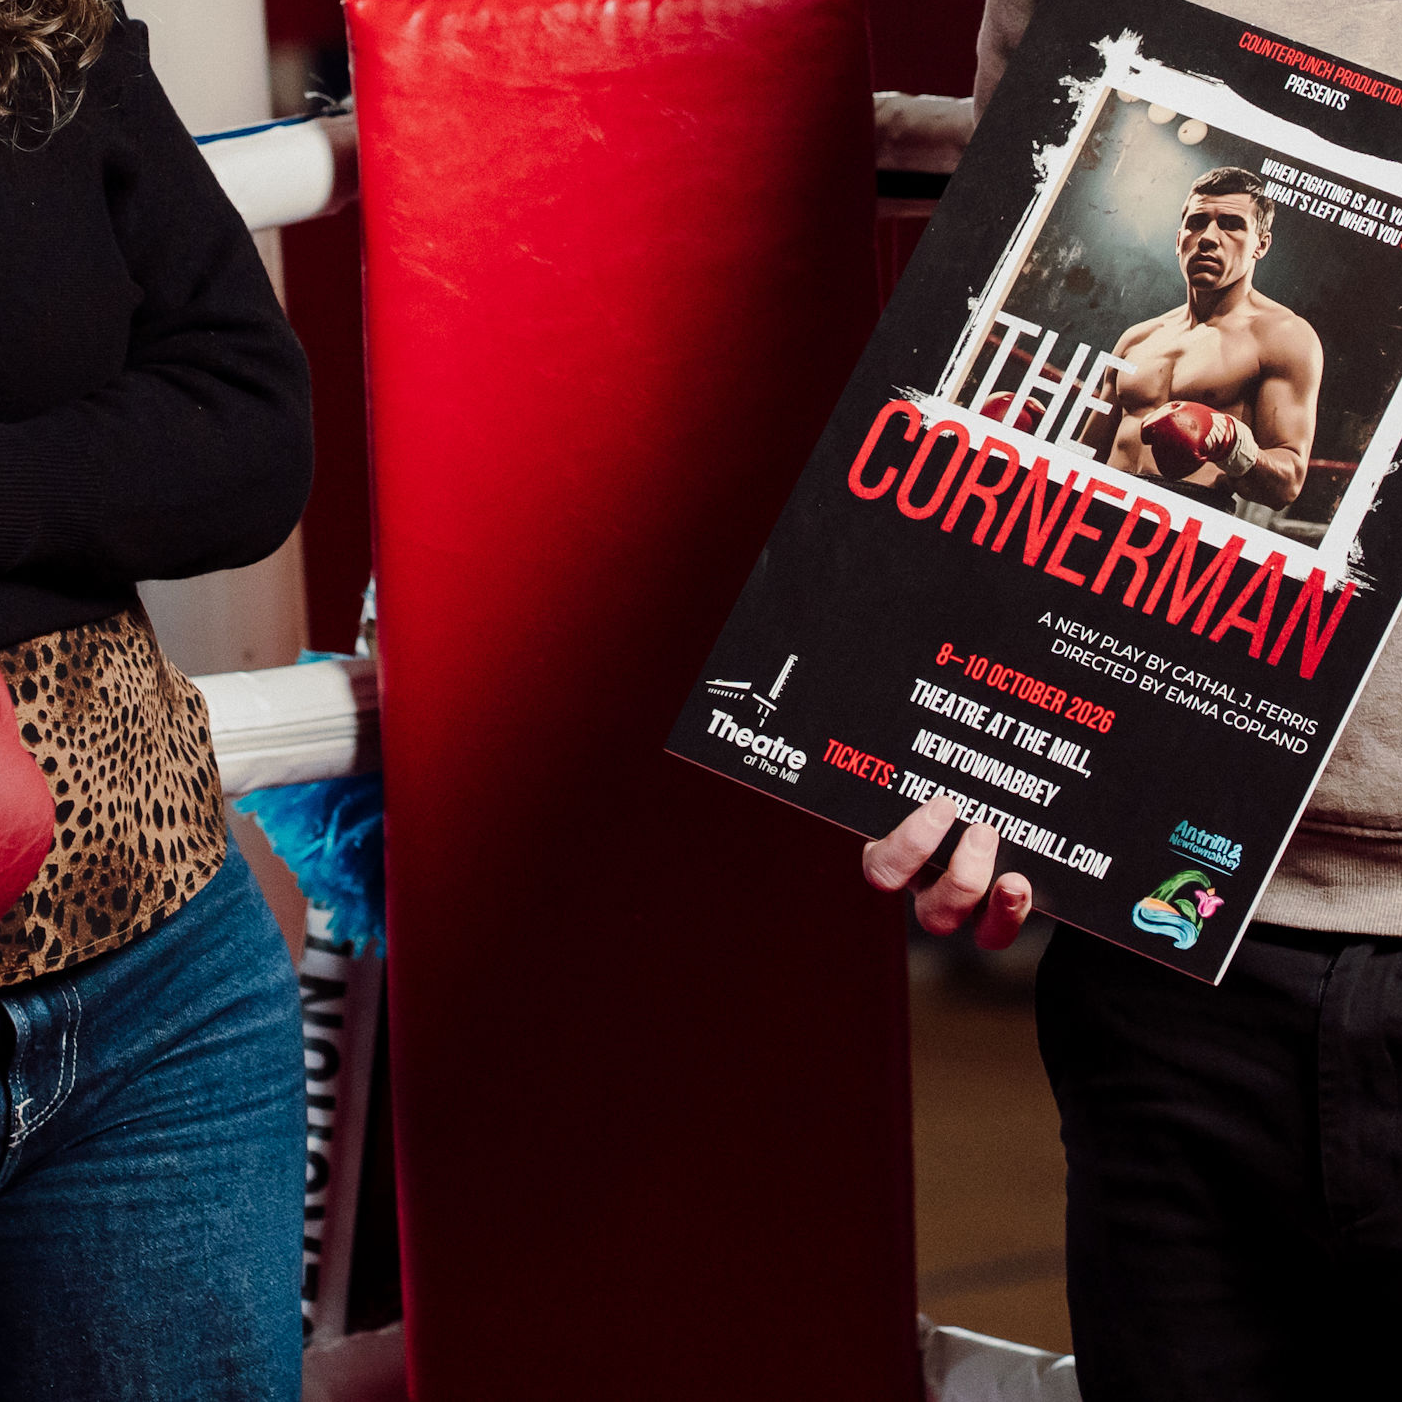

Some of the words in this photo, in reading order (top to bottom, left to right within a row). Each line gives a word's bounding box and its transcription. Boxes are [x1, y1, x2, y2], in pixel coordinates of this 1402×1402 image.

[1238, 31, 1336, 80] COUNTERPUNCH
[1284, 73, 1351, 111] PRESENTS
[1260, 158, 1299, 186] WHEN
[1296, 170, 1352, 207] FIGHTING
[1350, 192, 1366, 211] IS
[1363, 198, 1389, 221] ALL
[1262, 181, 1311, 212] WHAT'S
[1308, 200, 1341, 223] LEFT
[1339, 209, 1379, 238] WHEN
[968, 310, 1138, 460] THE
[847, 399, 1358, 681] CORNERMAN
[986, 663, 1068, 715] OCTOBER
[1064, 696, 1116, 734] 2026
[1038, 611, 1052, 628] A
[1054, 616, 1101, 645] NEW
[1099, 634, 1147, 664] PLAY
[1145, 653, 1172, 674] BY
[1171, 665, 1237, 705] CATHAL
[1239, 692, 1252, 711] J.
[1255, 699, 1319, 736] FERRIS
[1051, 638, 1138, 685] DIRECTED
[1139, 673, 1166, 695] BY
[1164, 685, 1219, 720] EMMA
[1222, 709, 1309, 756] COPLAND
[707, 708, 807, 770] Theatre
[909, 678, 991, 731] THEATRE
[984, 712, 1016, 740] AT
[1012, 721, 1052, 757] THE
[1047, 737, 1092, 779] MILL,
[743, 754, 758, 766] at
[758, 758, 779, 776] The
[779, 767, 800, 785] Mill
[822, 738, 899, 790] TICKETS:
[911, 728, 1061, 808] NEWTOWNABBEY
[1169, 832, 1240, 871] Newtownabbey
[1175, 820, 1232, 855] Antrim
